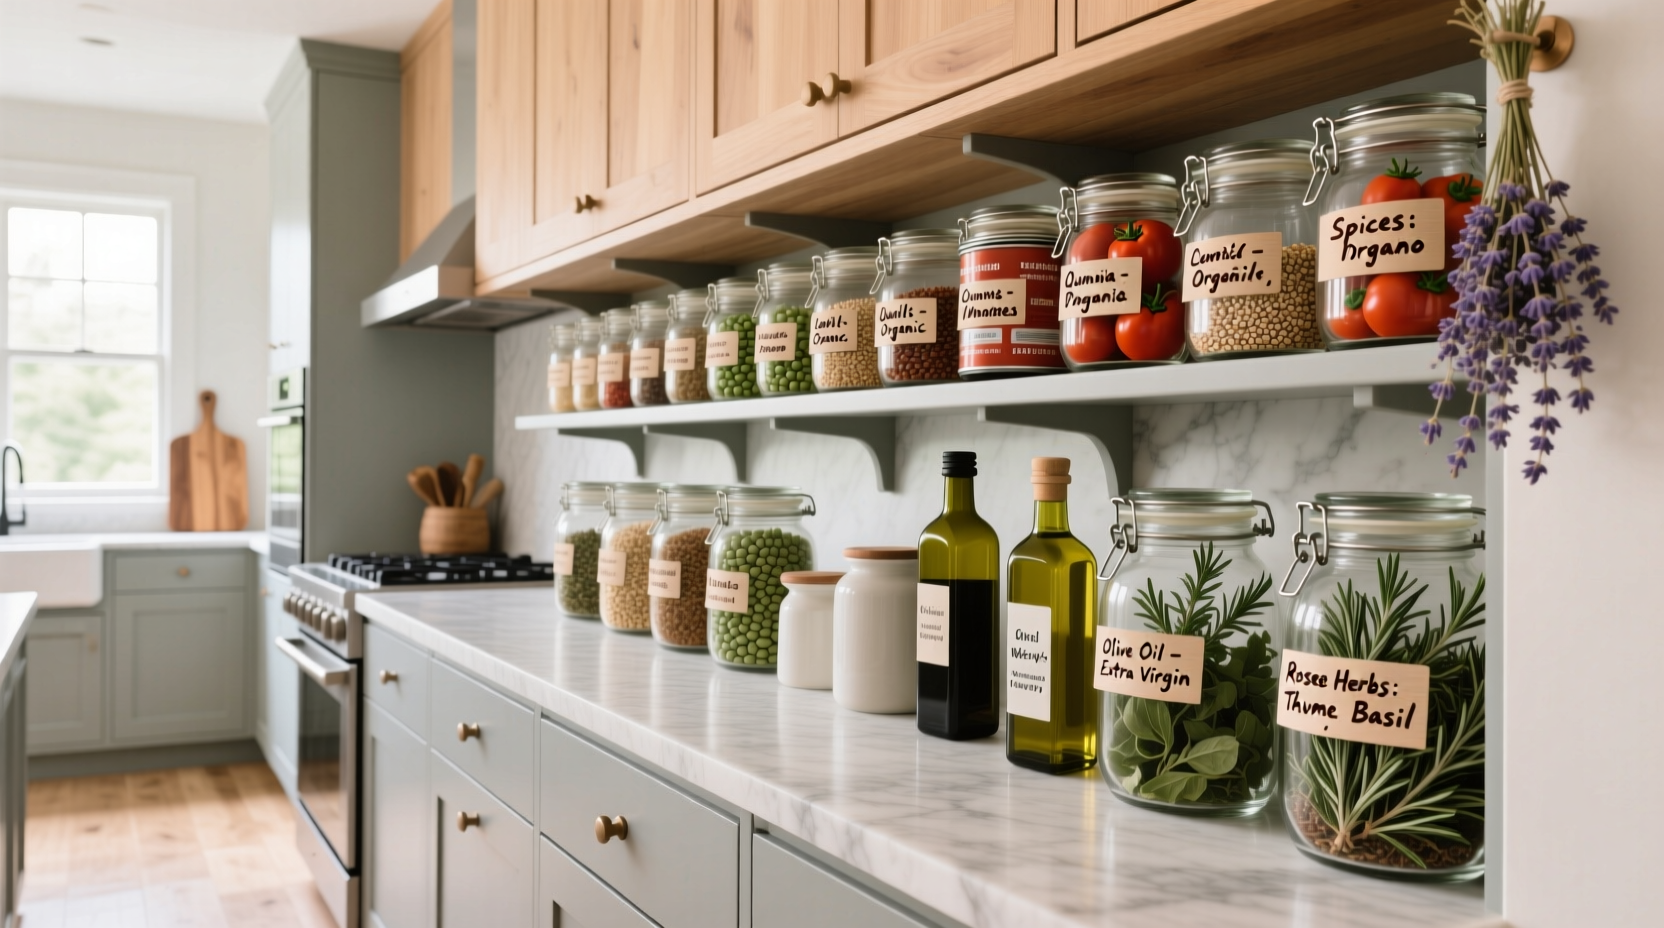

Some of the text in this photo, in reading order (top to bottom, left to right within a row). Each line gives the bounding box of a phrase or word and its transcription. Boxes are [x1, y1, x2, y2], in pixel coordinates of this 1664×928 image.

[1330, 213, 1415, 248] Spices:
[1102, 637, 1133, 658] Olive
[1139, 641, 1165, 662] Oil
[1140, 666, 1190, 693] Virgin
[1333, 669, 1398, 698] Herbs:
[1351, 700, 1416, 729] Basil
